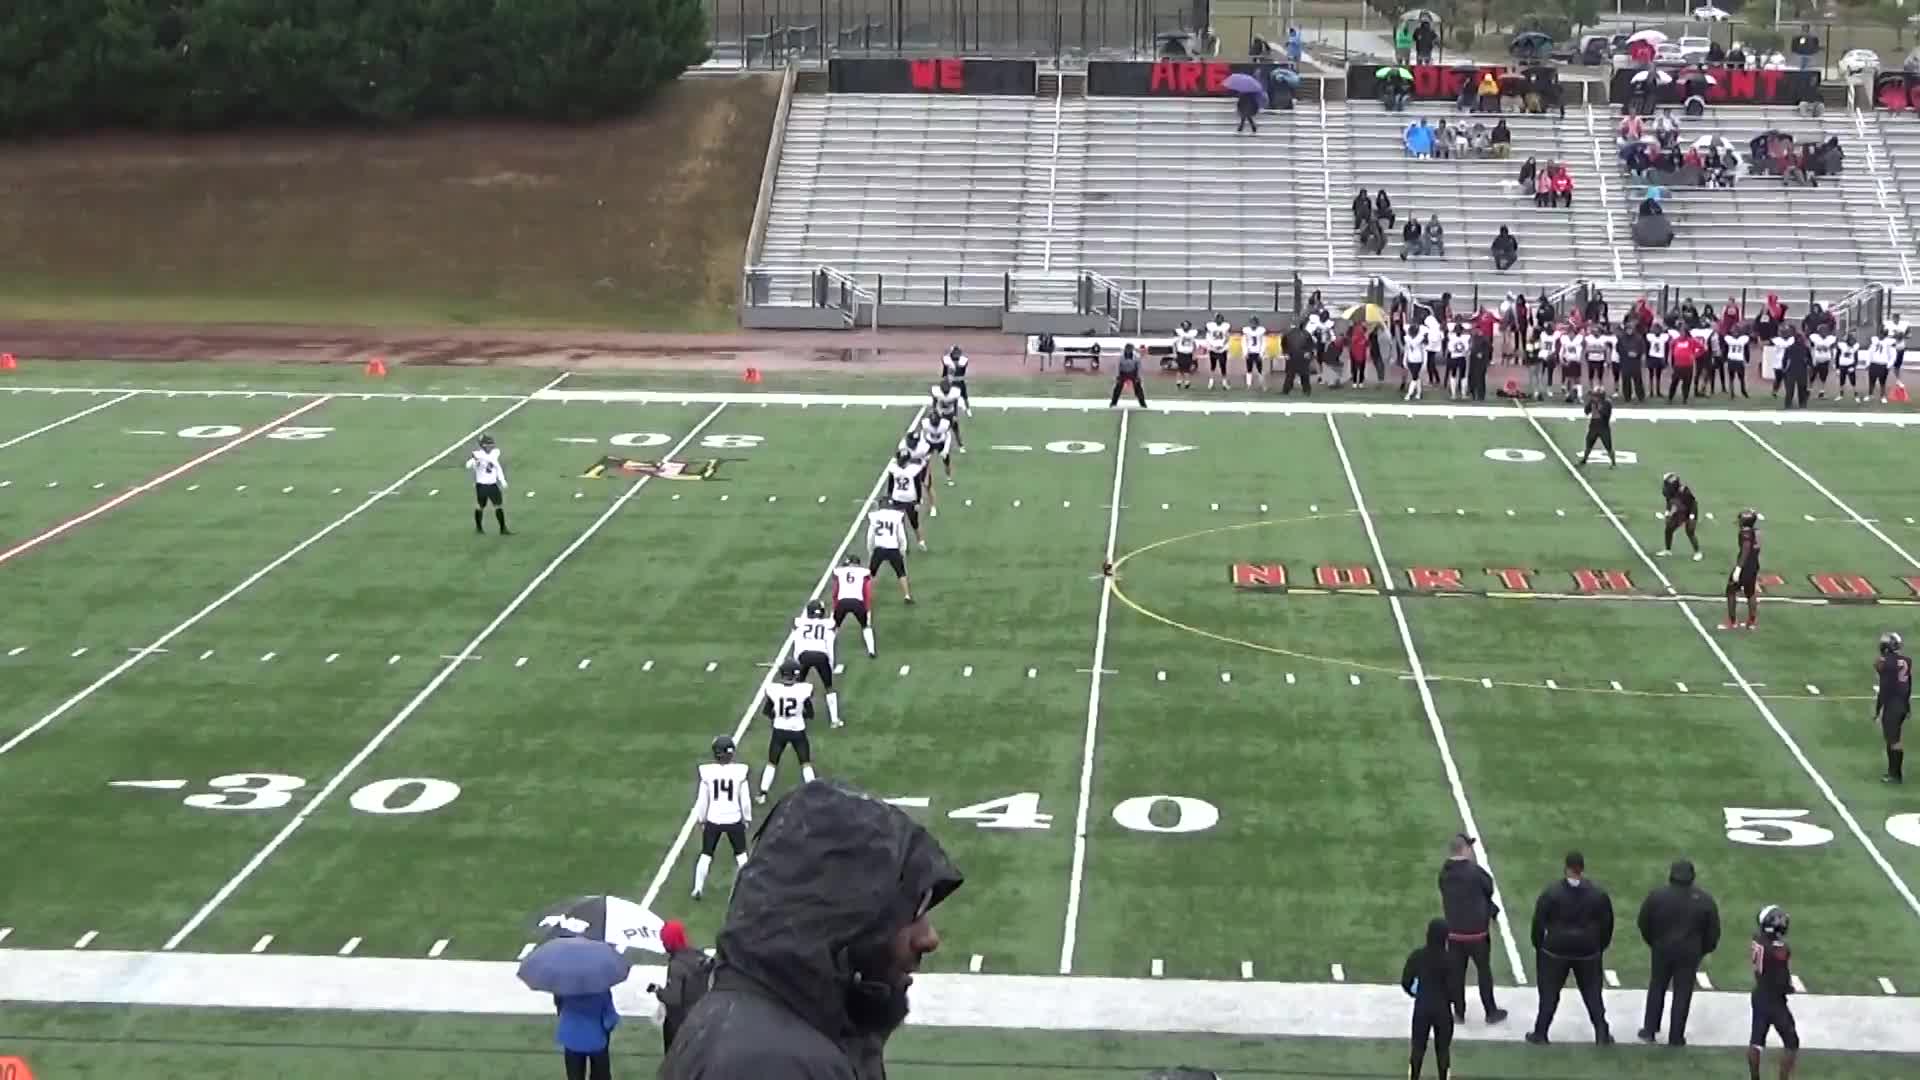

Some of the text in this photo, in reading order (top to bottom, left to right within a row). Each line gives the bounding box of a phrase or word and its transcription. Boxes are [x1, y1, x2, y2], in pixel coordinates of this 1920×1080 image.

[911, 59, 962, 89] WE
[1151, 61, 1230, 92] ARE
[875, 520, 894, 537] 24
[846, 572, 855, 584] 6
[1230, 563, 1635, 591] NORTH
[803, 624, 825, 640] 20
[1896, 659, 1909, 683] 2
[778, 697, 797, 718] 12
[183, 773, 461, 813] 30
[713, 779, 734, 801] 14
[947, 792, 1219, 833] 40
